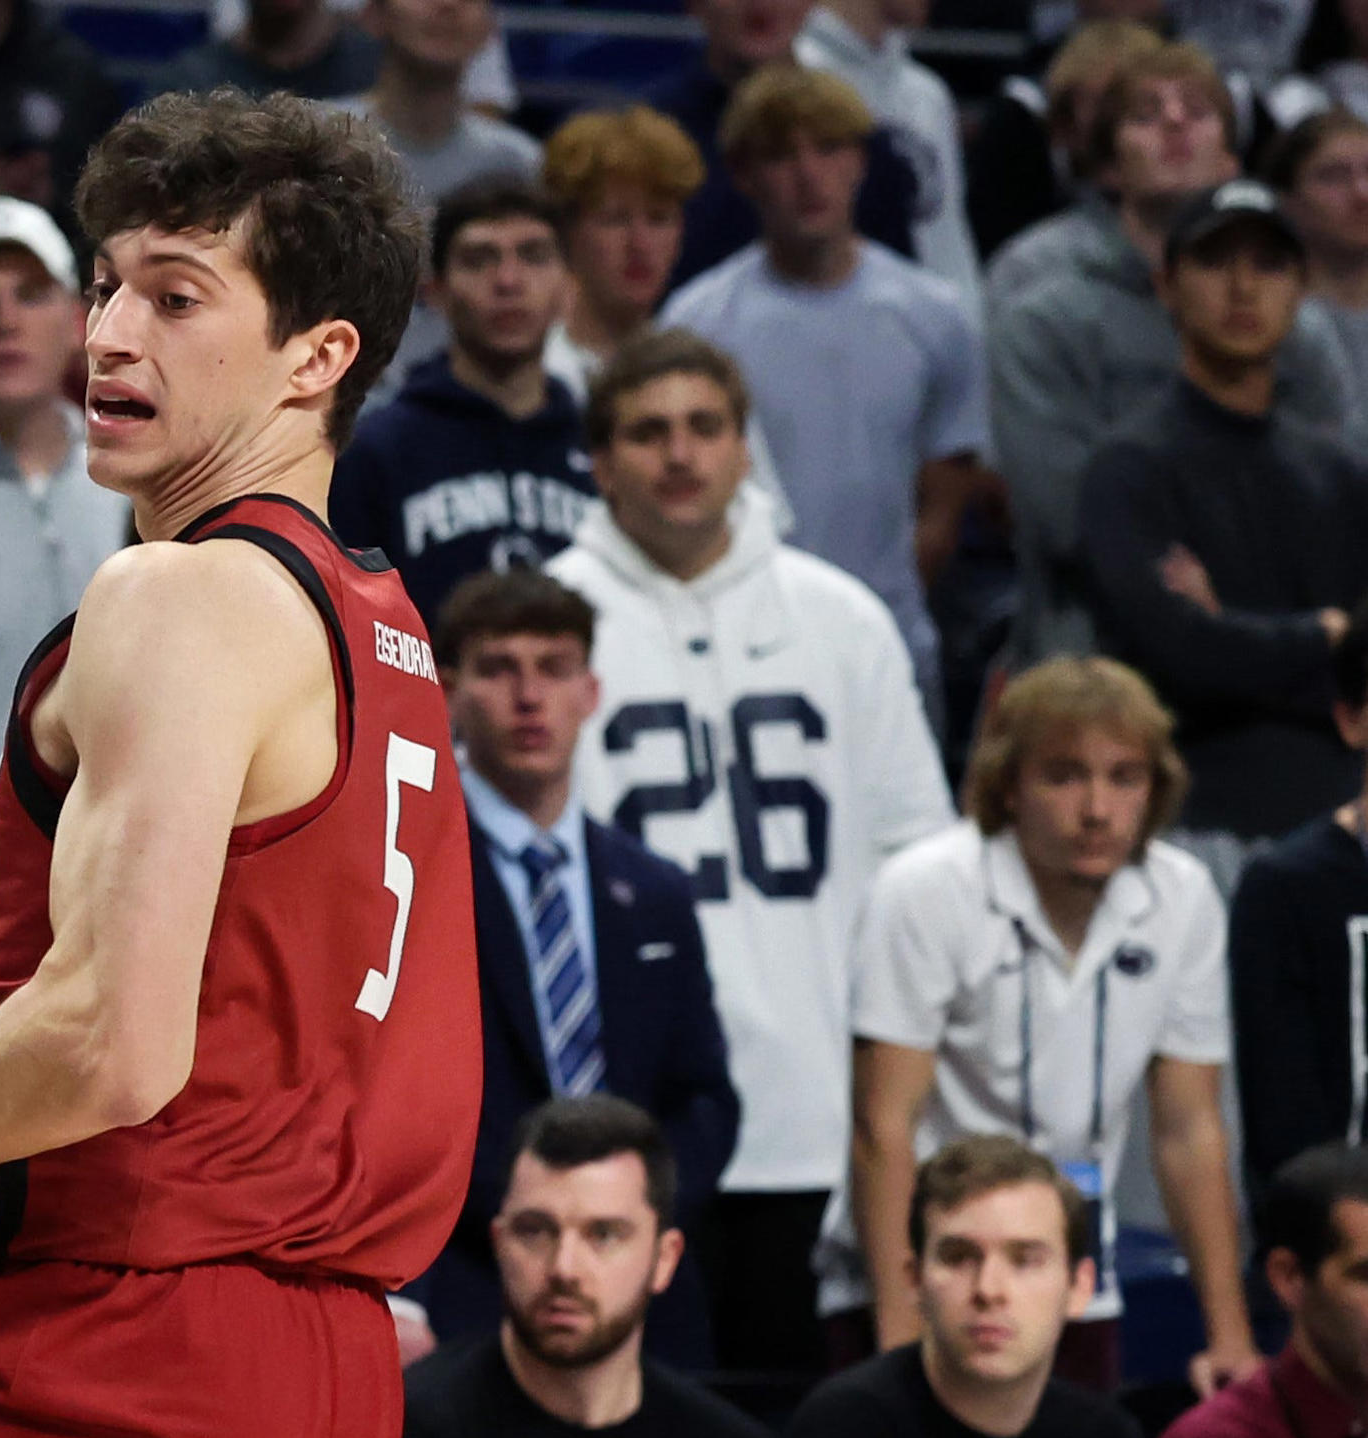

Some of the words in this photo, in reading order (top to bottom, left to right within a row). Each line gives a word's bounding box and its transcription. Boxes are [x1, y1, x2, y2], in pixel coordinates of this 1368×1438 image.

[402, 470, 511, 557] PENN
[354, 730, 437, 1022] 5
[603, 692, 831, 901] 26
